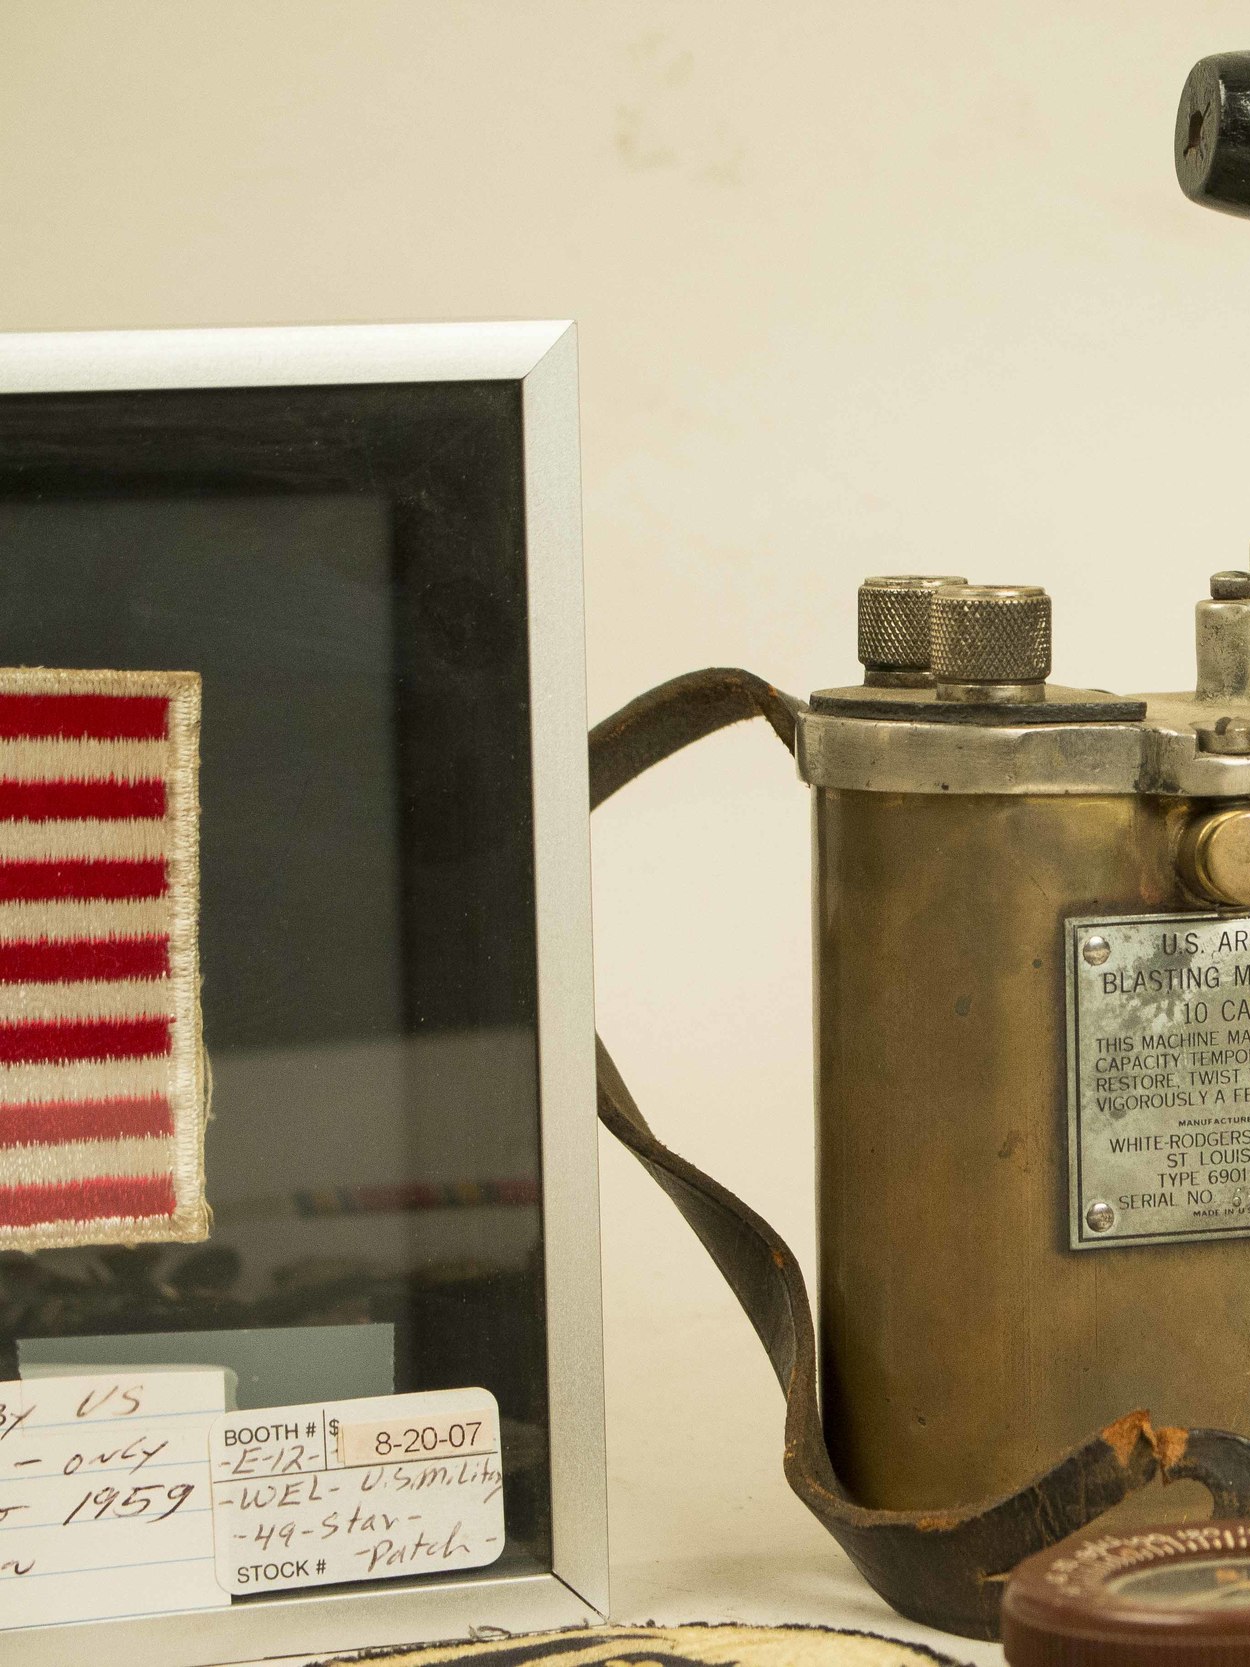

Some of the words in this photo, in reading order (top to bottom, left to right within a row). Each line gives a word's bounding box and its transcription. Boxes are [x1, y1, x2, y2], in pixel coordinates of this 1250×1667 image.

[1162, 932, 1205, 955] U.S.
[1103, 966, 1220, 994] BLASTING
[1184, 1001, 1208, 1024] 10
[1096, 1037, 1134, 1054] THIS
[1142, 1031, 1219, 1050] MACHINE
[1095, 1053, 1181, 1073] CAPACITY
[1096, 1073, 1181, 1093] RESTORE,
[1188, 1068, 1240, 1087] TWIST
[1096, 1091, 1209, 1112] VIGOROUSLY
[1215, 1089, 1226, 1104] A
[1157, 1170, 1200, 1188] TYPE
[1208, 1167, 1247, 1185] 6901
[1119, 1192, 1179, 1210] SERIAL
[1193, 1208, 1220, 1218] MADE
[1224, 1207, 1235, 1216] IN
[224, 1422, 299, 1447] BOOTH
[306, 1422, 317, 1438] #
[375, 1421, 483, 1456] 8-20-07
[62, 1483, 195, 1526] 1959
[236, 1560, 310, 1584] STOCK
[316, 1558, 327, 1574] #
